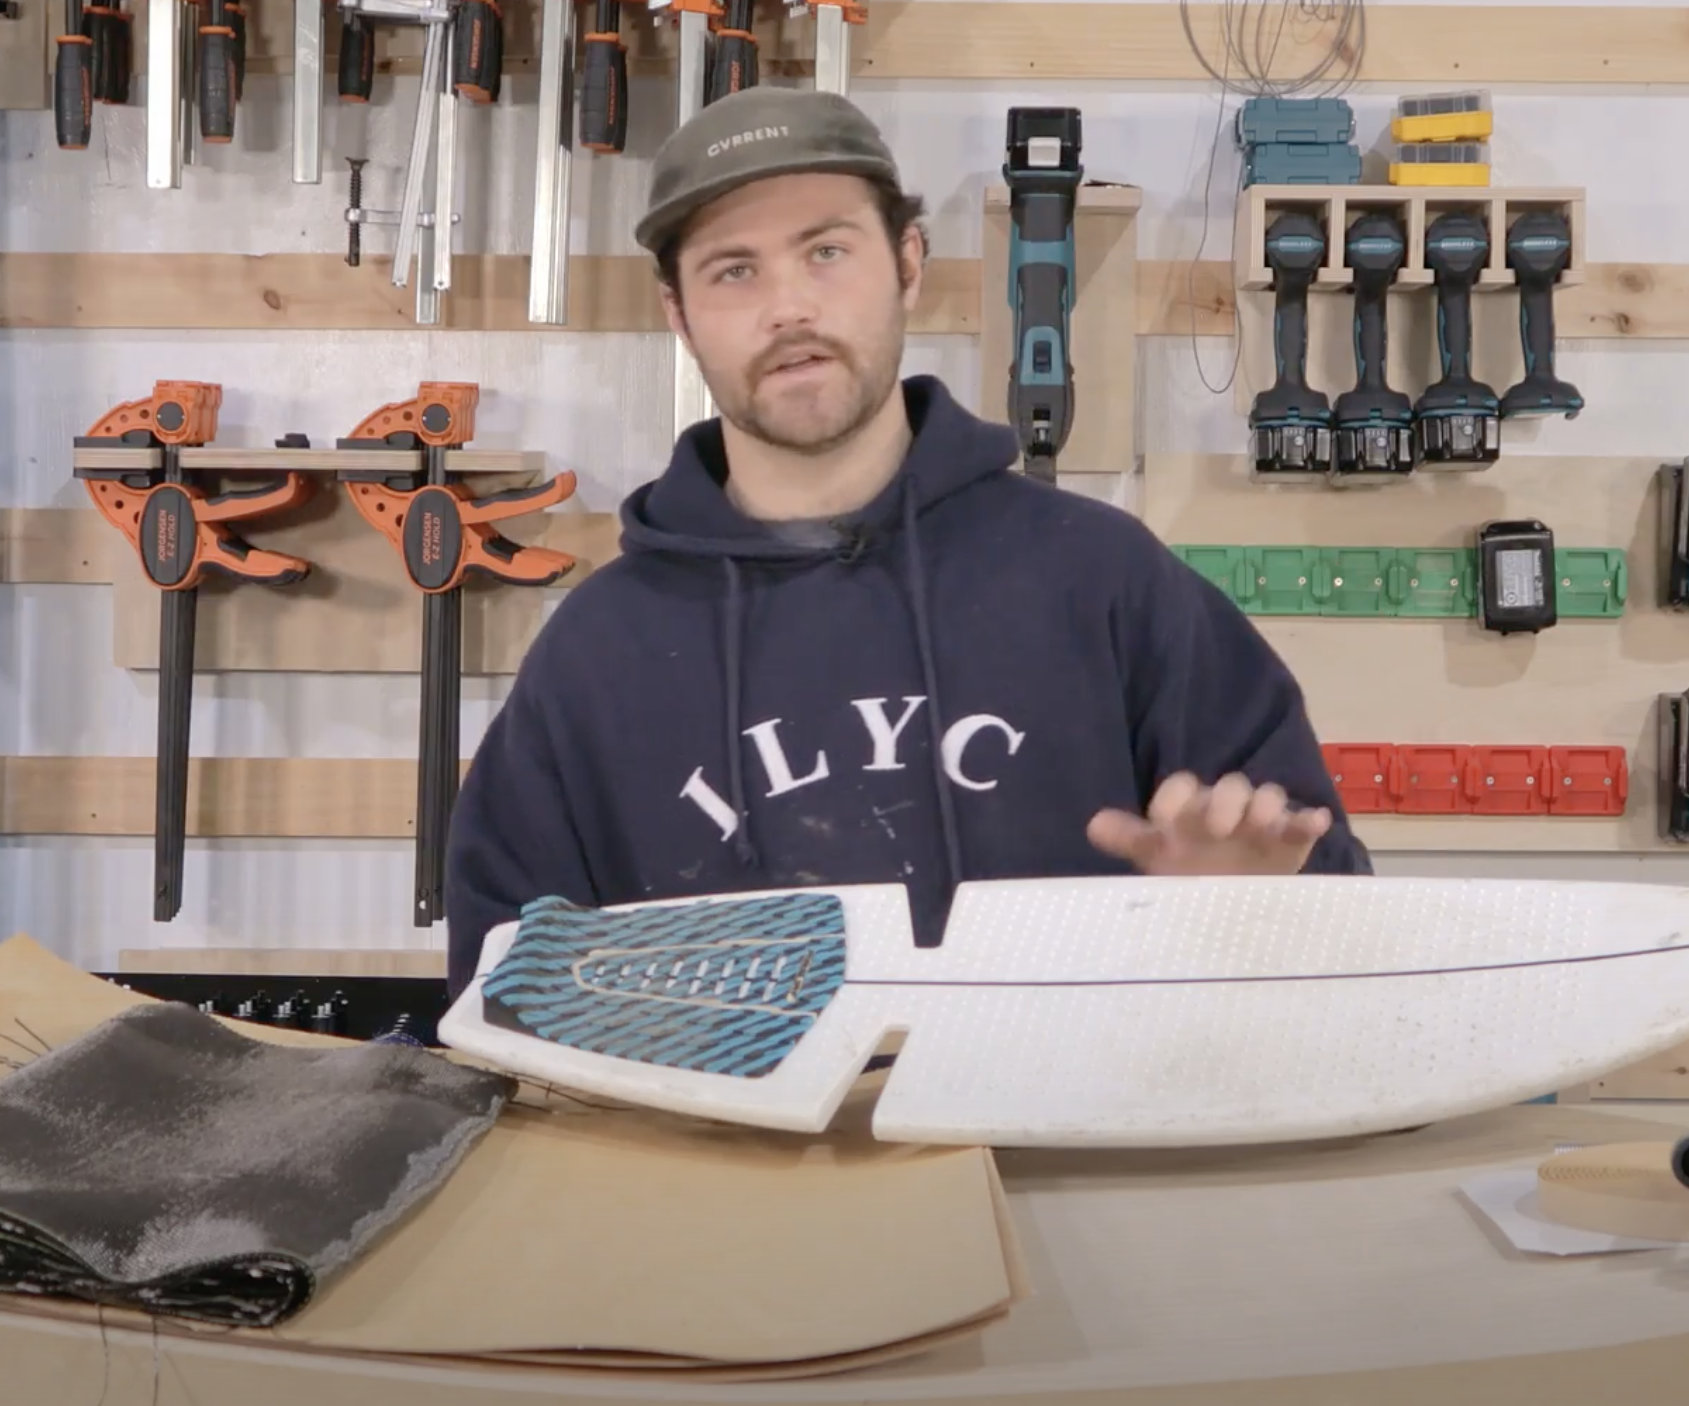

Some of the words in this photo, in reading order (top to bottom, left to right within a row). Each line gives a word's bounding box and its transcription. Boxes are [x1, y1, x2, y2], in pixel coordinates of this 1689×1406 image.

[707, 126, 789, 157] CVRRENT
[157, 509, 167, 562] JORGENSEN
[167, 514, 175, 541] HOLD
[423, 512, 432, 565] JORGENSEN
[432, 517, 441, 543] HOLD
